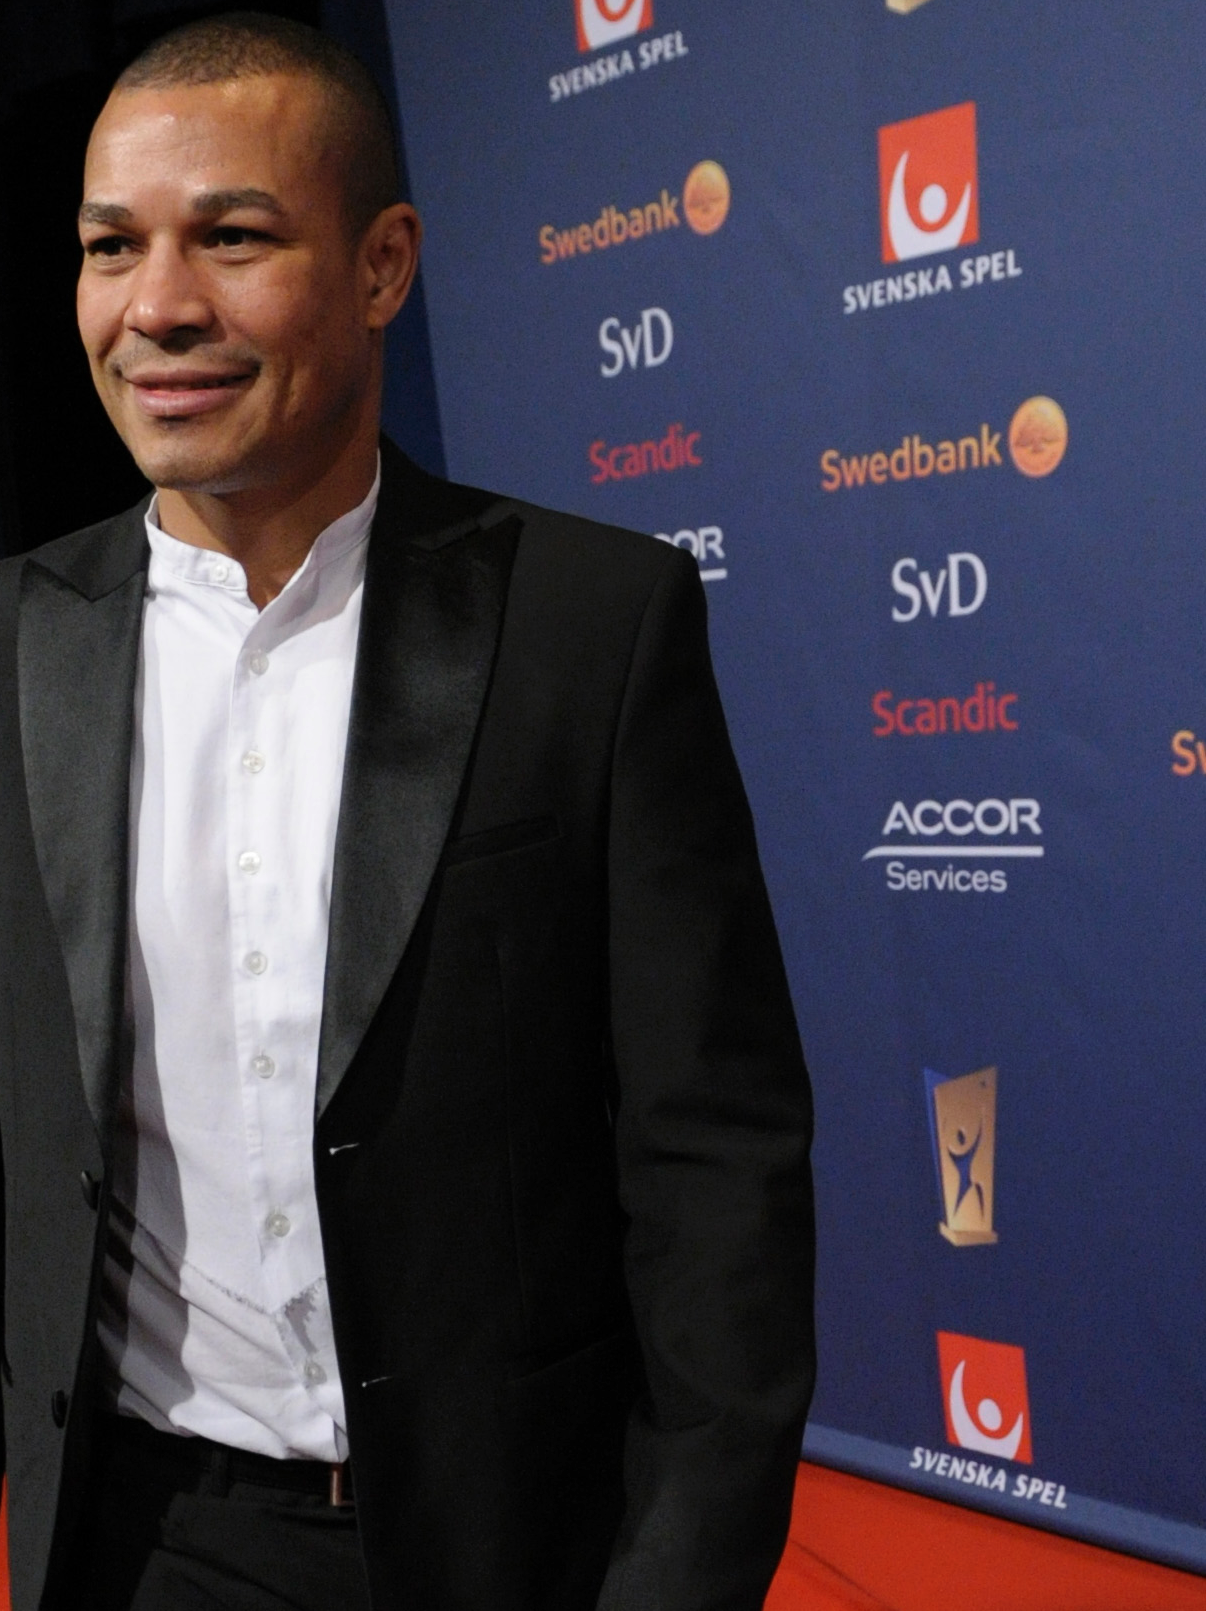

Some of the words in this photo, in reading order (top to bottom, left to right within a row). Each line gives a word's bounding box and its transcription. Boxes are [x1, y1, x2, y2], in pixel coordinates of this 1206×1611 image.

[549, 50, 635, 101] SVENSKA
[639, 30, 688, 69] SPEL
[539, 189, 681, 264] Swedbank
[843, 264, 953, 314] SVENSKA
[959, 249, 1022, 288] SPEL
[599, 307, 674, 377] SvD
[588, 422, 703, 484] Scandic
[820, 423, 1003, 492] Swedbank
[891, 552, 988, 622] SvD
[871, 681, 1019, 737] Scandic
[882, 798, 1043, 836] ACCOR
[886, 860, 1008, 893] Services
[909, 1446, 1007, 1492] SVENSKA
[1012, 1474, 1067, 1509] SPEL
